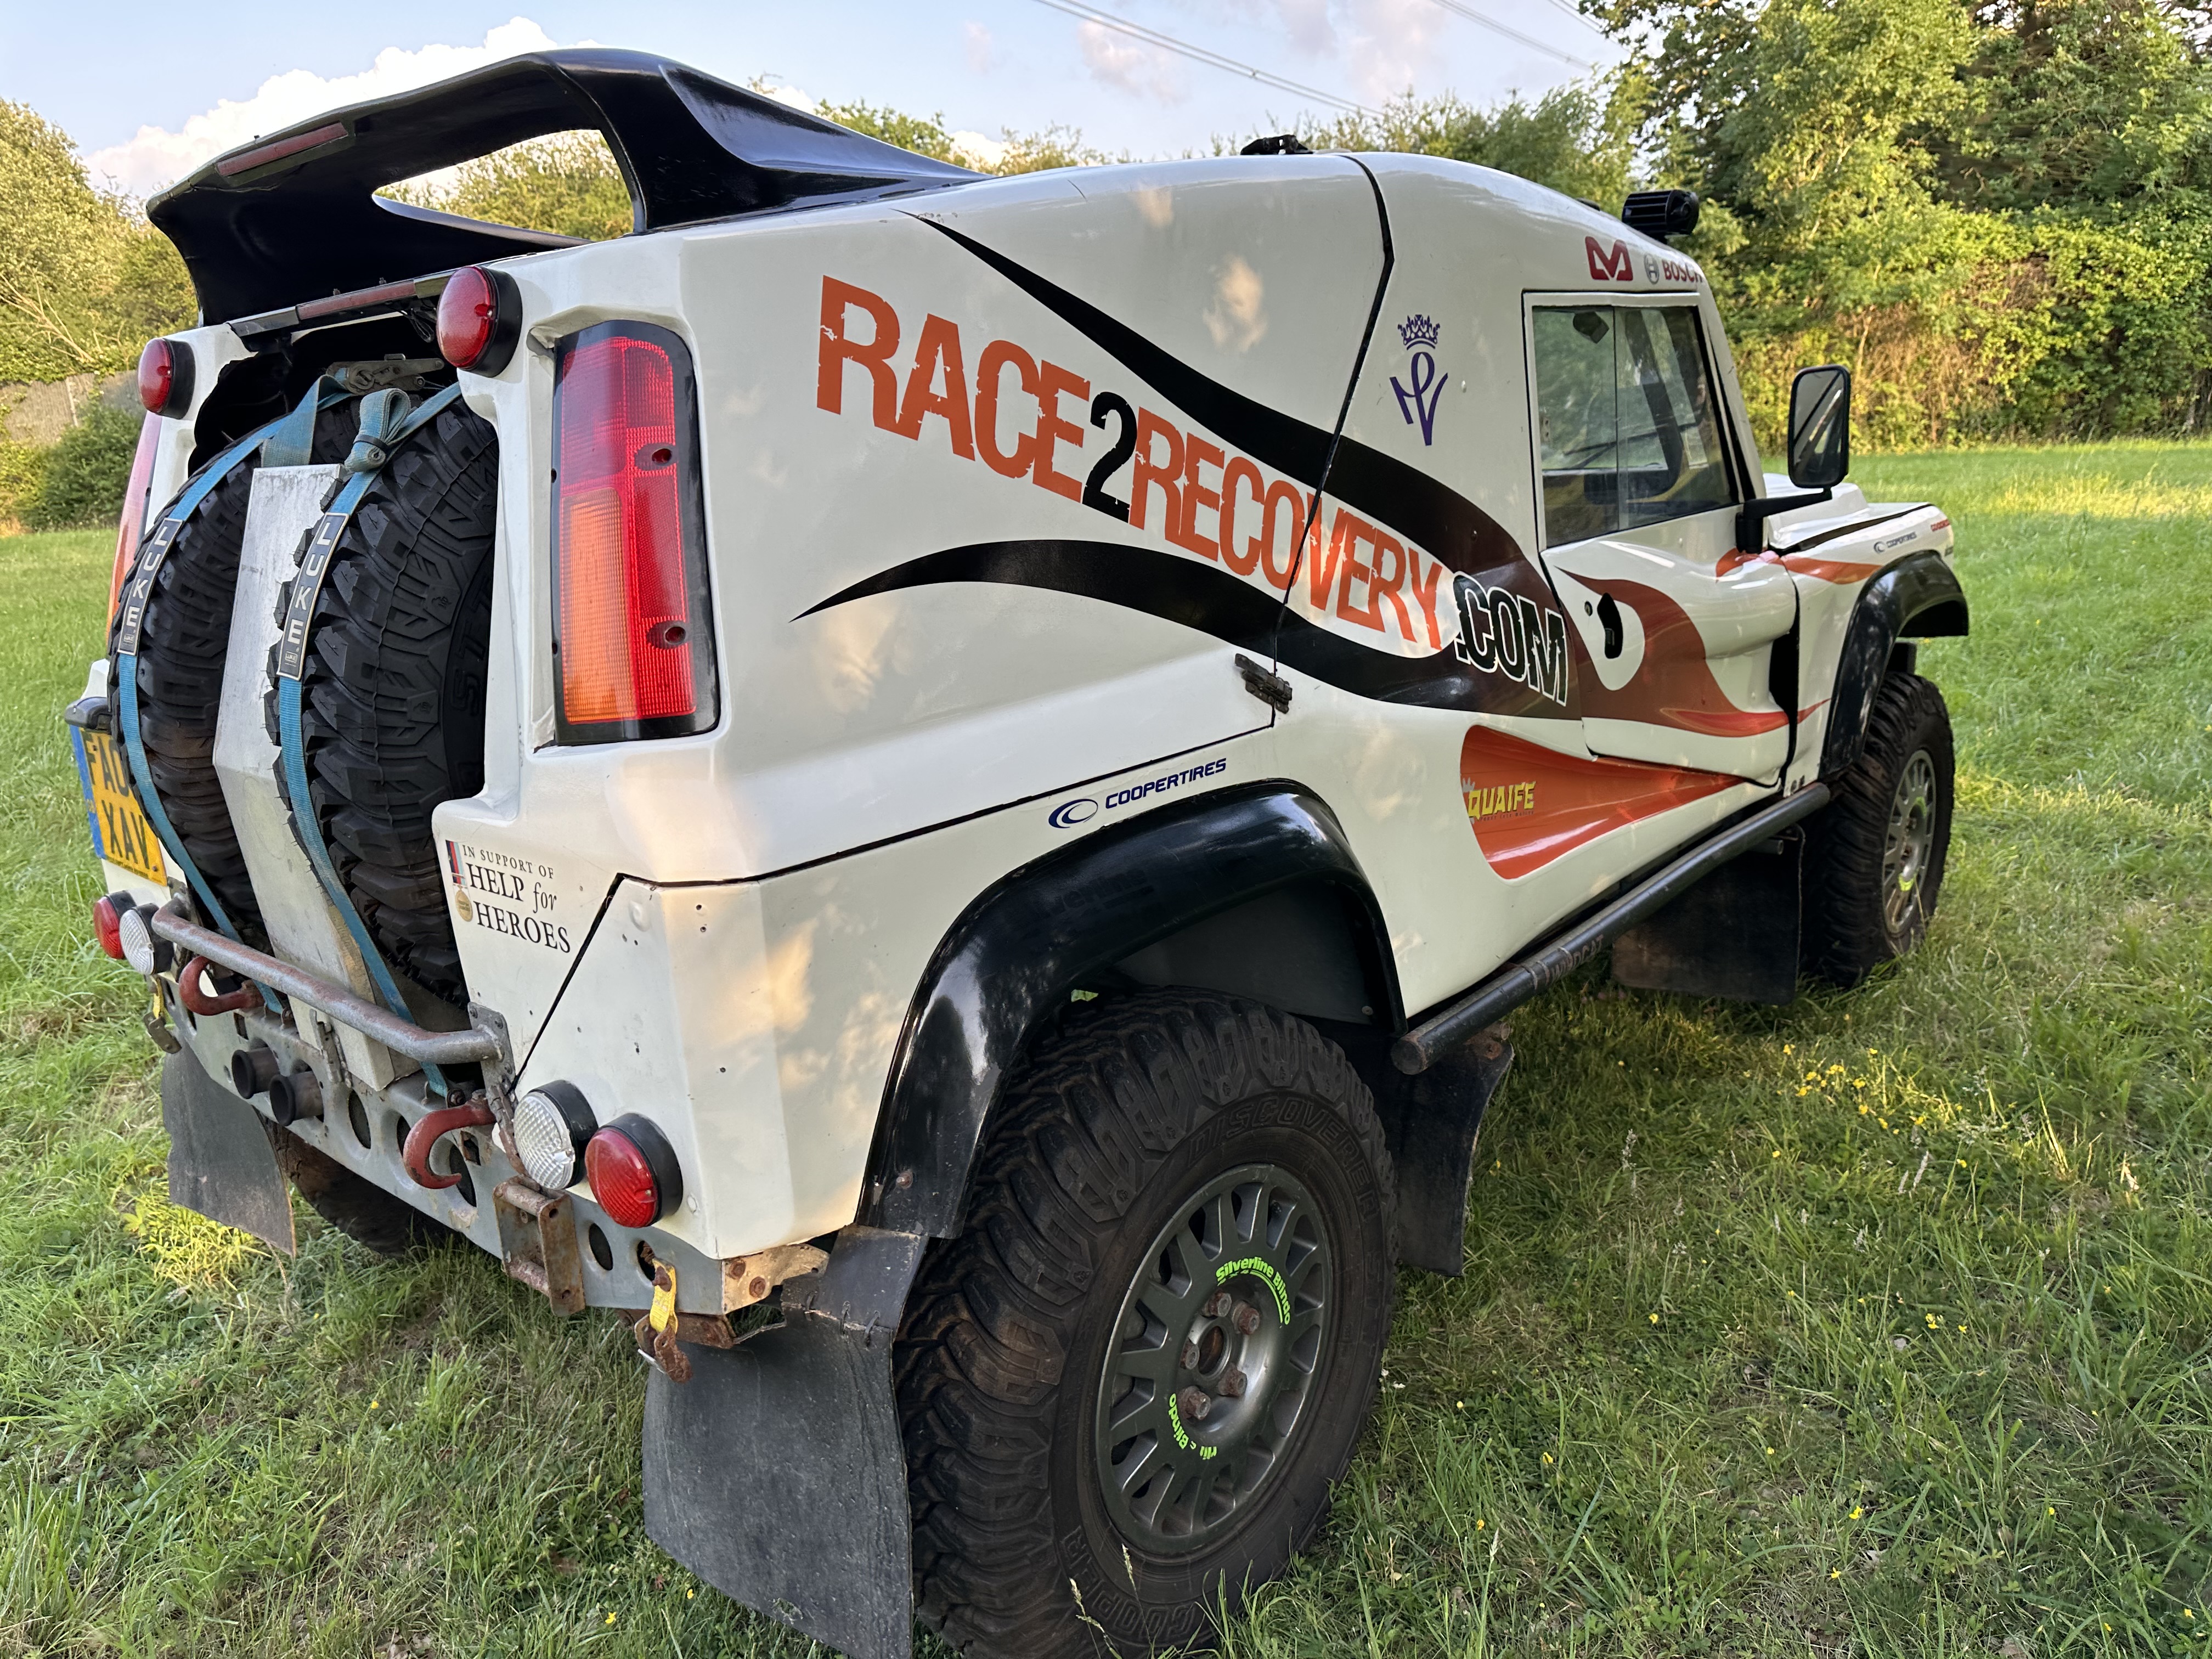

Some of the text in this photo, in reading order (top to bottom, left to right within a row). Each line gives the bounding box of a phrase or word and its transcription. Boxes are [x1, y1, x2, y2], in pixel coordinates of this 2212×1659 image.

[1662, 259, 1703, 283] BOSCH
[126, 526, 167, 627] LUKE
[287, 522, 331, 645] LUKE
[1105, 758, 1227, 809] COOPERTIRES
[1468, 781, 1537, 821] QUAIFE
[101, 800, 150, 870] XAV
[462, 845, 554, 879] IN SUPPORT OF
[465, 862, 557, 914] HELP for
[473, 901, 571, 953] HEROES
[1187, 1096, 1381, 1222] DISCOVERER
[1215, 1256, 1291, 1325] Silverline Blindo
[1168, 1392, 1189, 1450] Blindo
